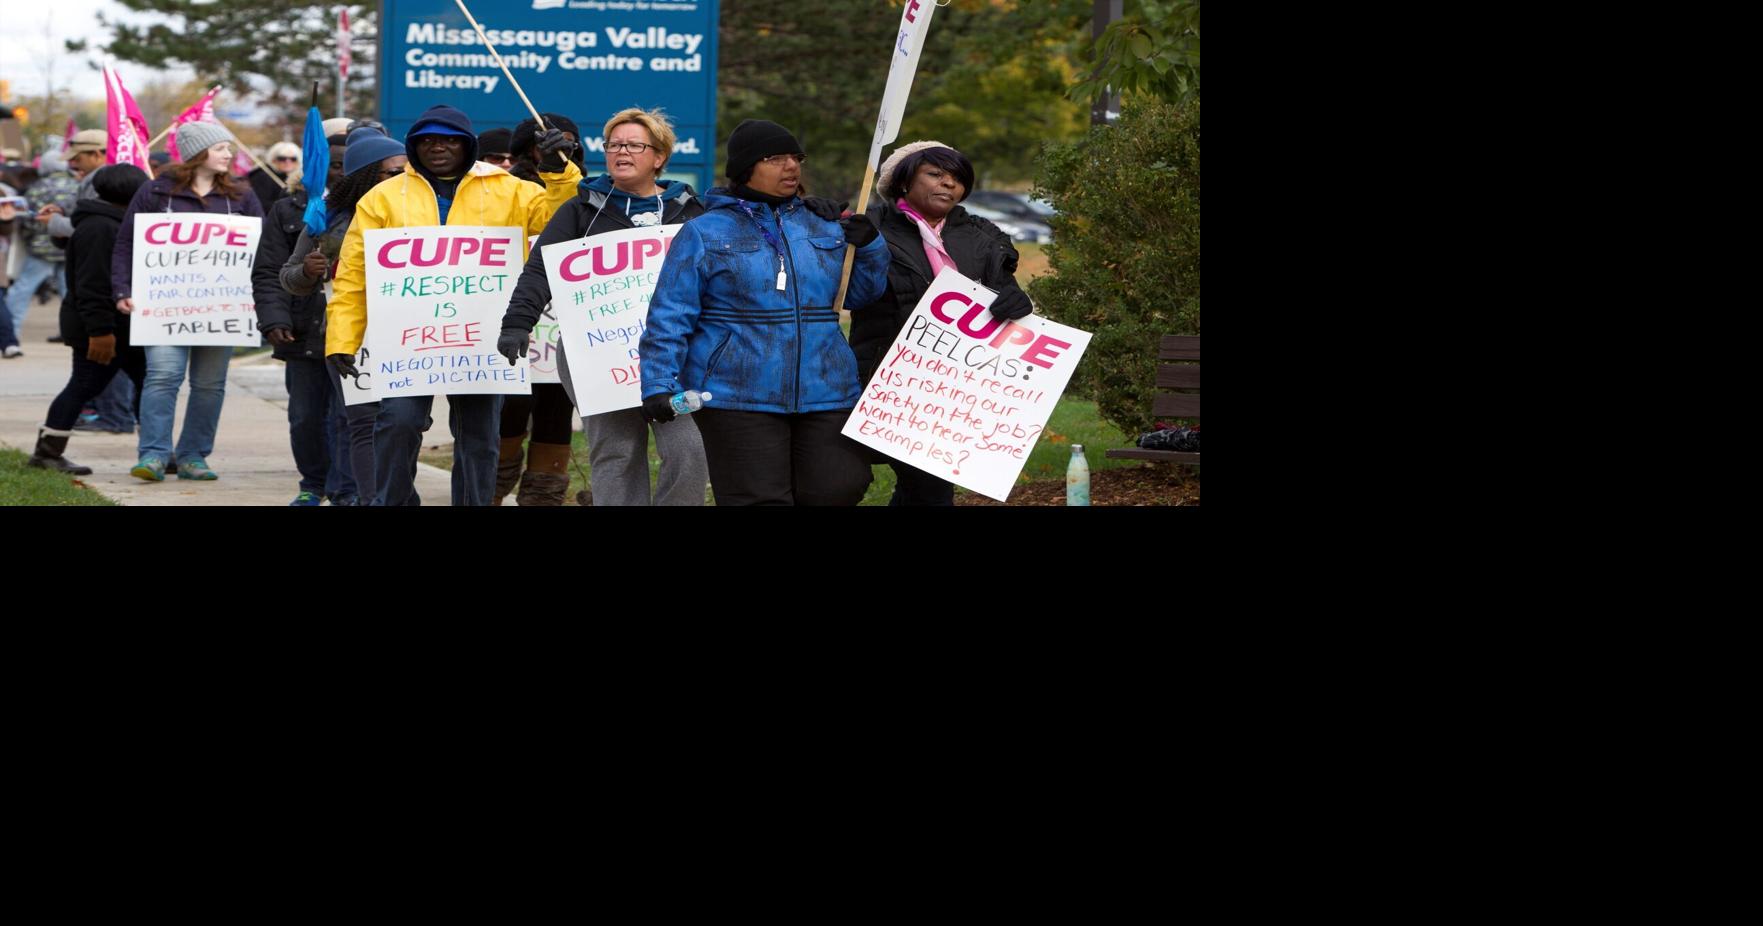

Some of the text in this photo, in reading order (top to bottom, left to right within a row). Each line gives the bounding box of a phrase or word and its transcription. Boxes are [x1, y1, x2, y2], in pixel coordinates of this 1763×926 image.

[607, 1, 634, 12] today
[635, 1, 650, 11] for
[651, 2, 697, 11] tomorrow
[405, 22, 703, 54] Mississauga Valley
[405, 49, 701, 73] Community Centre and
[405, 71, 499, 93] Library
[144, 222, 250, 246] CUPE
[377, 237, 511, 269] CUPE
[559, 236, 674, 282] CUP
[149, 272, 227, 285] WANTS A
[380, 274, 508, 297] #RESPECT
[570, 271, 658, 306] #RESPEC
[149, 284, 252, 300] FAIR CONTRAC
[240, 303, 256, 313] TH
[434, 302, 457, 318] IS
[589, 299, 632, 322] FREE
[401, 322, 481, 346] FREE
[587, 318, 646, 348] Negot
[905, 314, 958, 362] PEEL
[930, 291, 1072, 370] CUPE
[381, 353, 503, 374] NEGOTIATE
[388, 367, 526, 390] not DICTATE!
[980, 377, 1044, 404] recall
[907, 377, 977, 415] risking
[981, 398, 1019, 416] our
[923, 402, 945, 419] on
[949, 407, 982, 430] the
[908, 415, 928, 431] to
[931, 420, 974, 444] hear
[859, 420, 970, 475] Examples?
